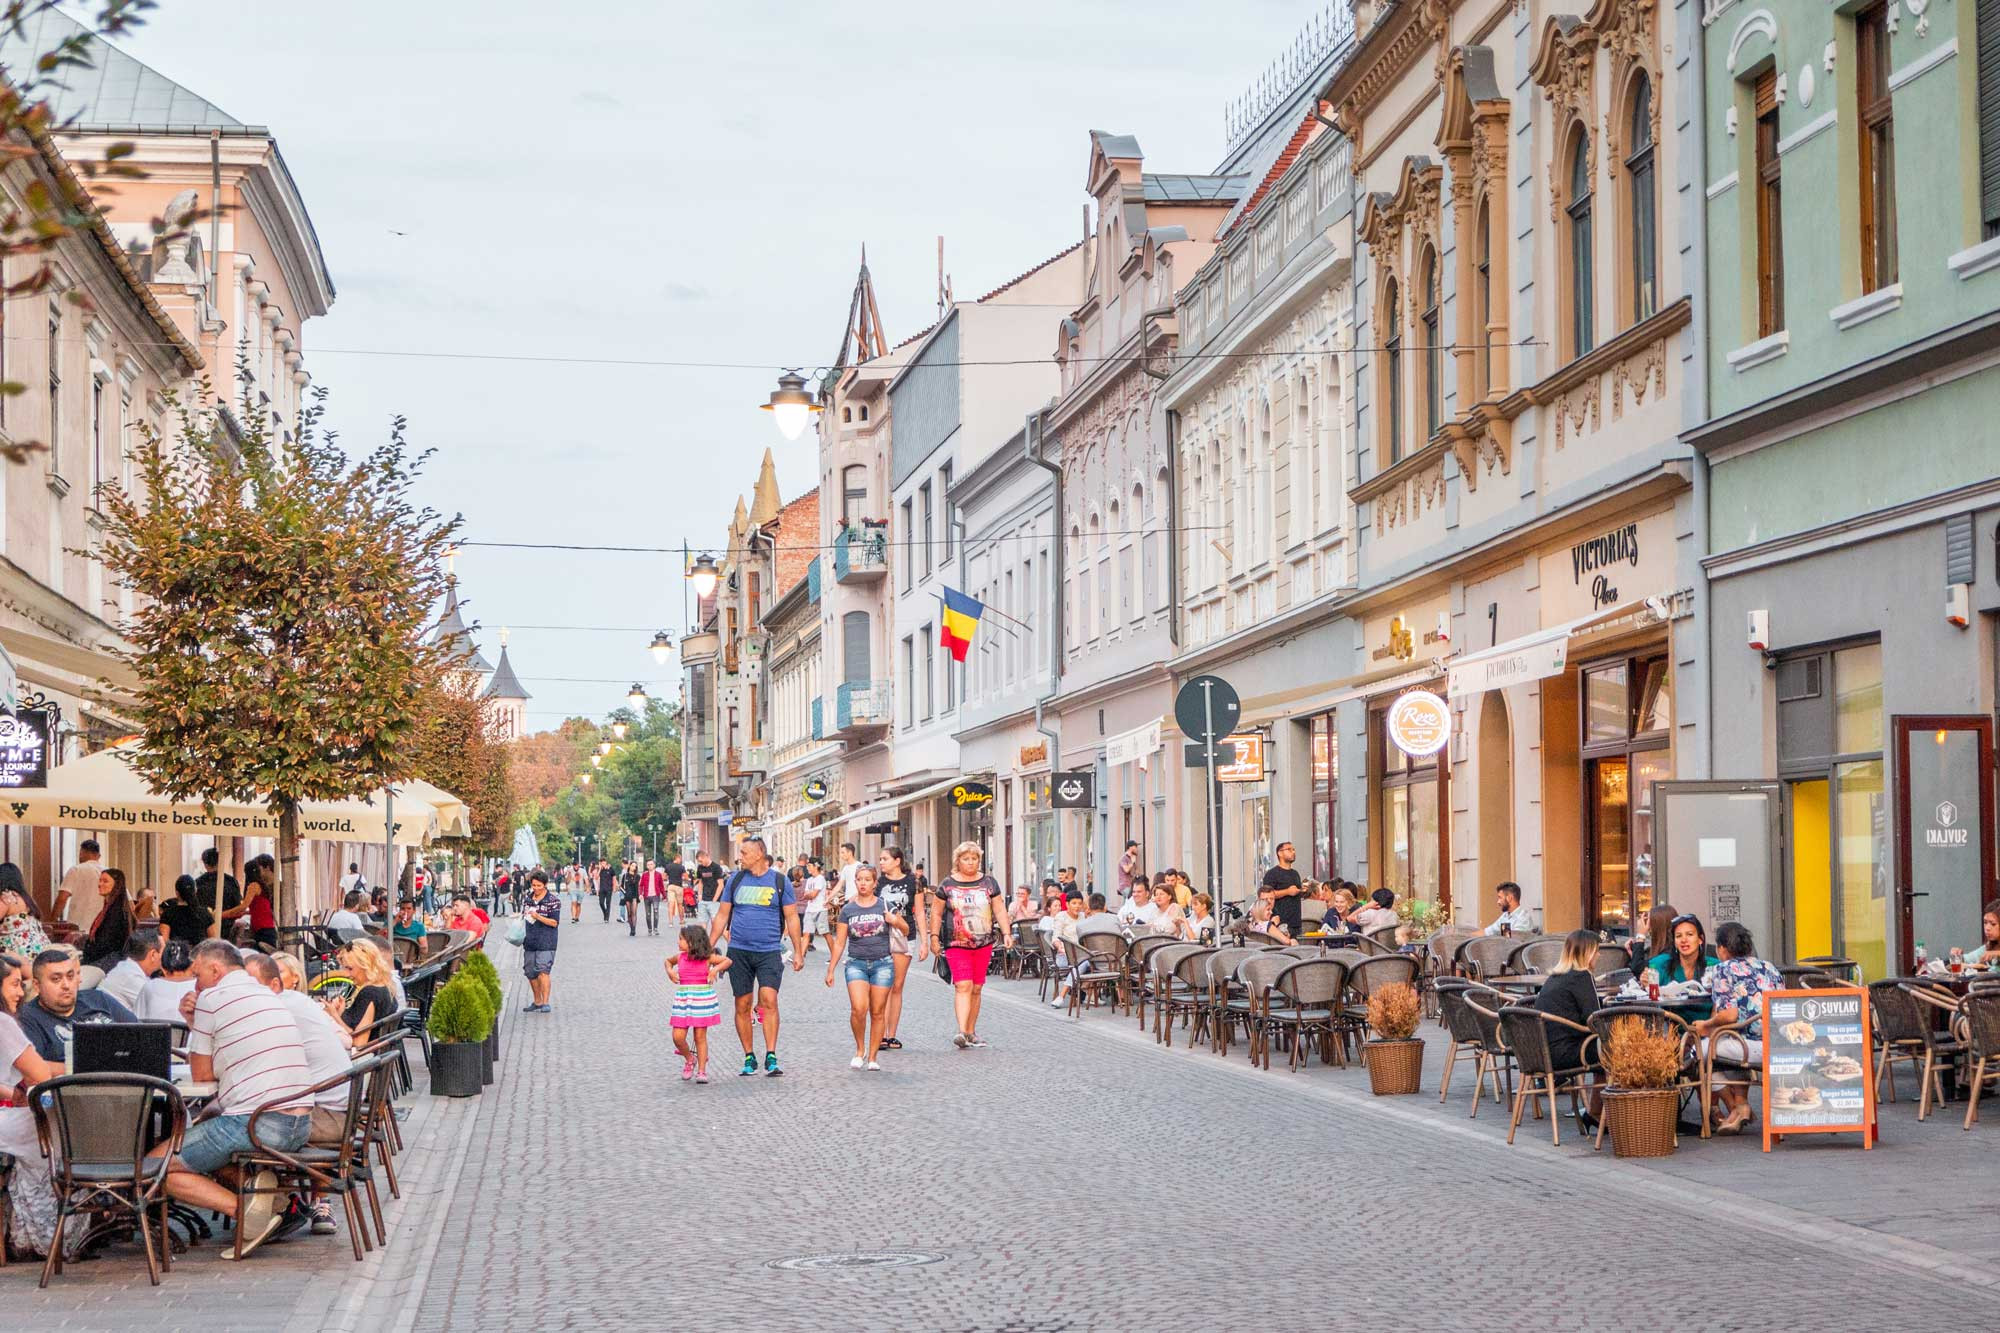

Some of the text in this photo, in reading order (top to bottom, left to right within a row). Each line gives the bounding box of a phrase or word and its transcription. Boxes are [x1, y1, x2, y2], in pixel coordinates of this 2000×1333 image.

[1571, 523, 1639, 585] VICTORIA'S
[1592, 574, 1619, 611] Place
[4, 762, 37, 771] LOUNGE
[58, 805, 137, 825] Probably
[141, 809, 168, 824] the
[172, 811, 207, 826] best
[252, 815, 268, 829] in
[303, 818, 355, 833] world.
[1821, 1001, 1858, 1014] SUVLAKI
